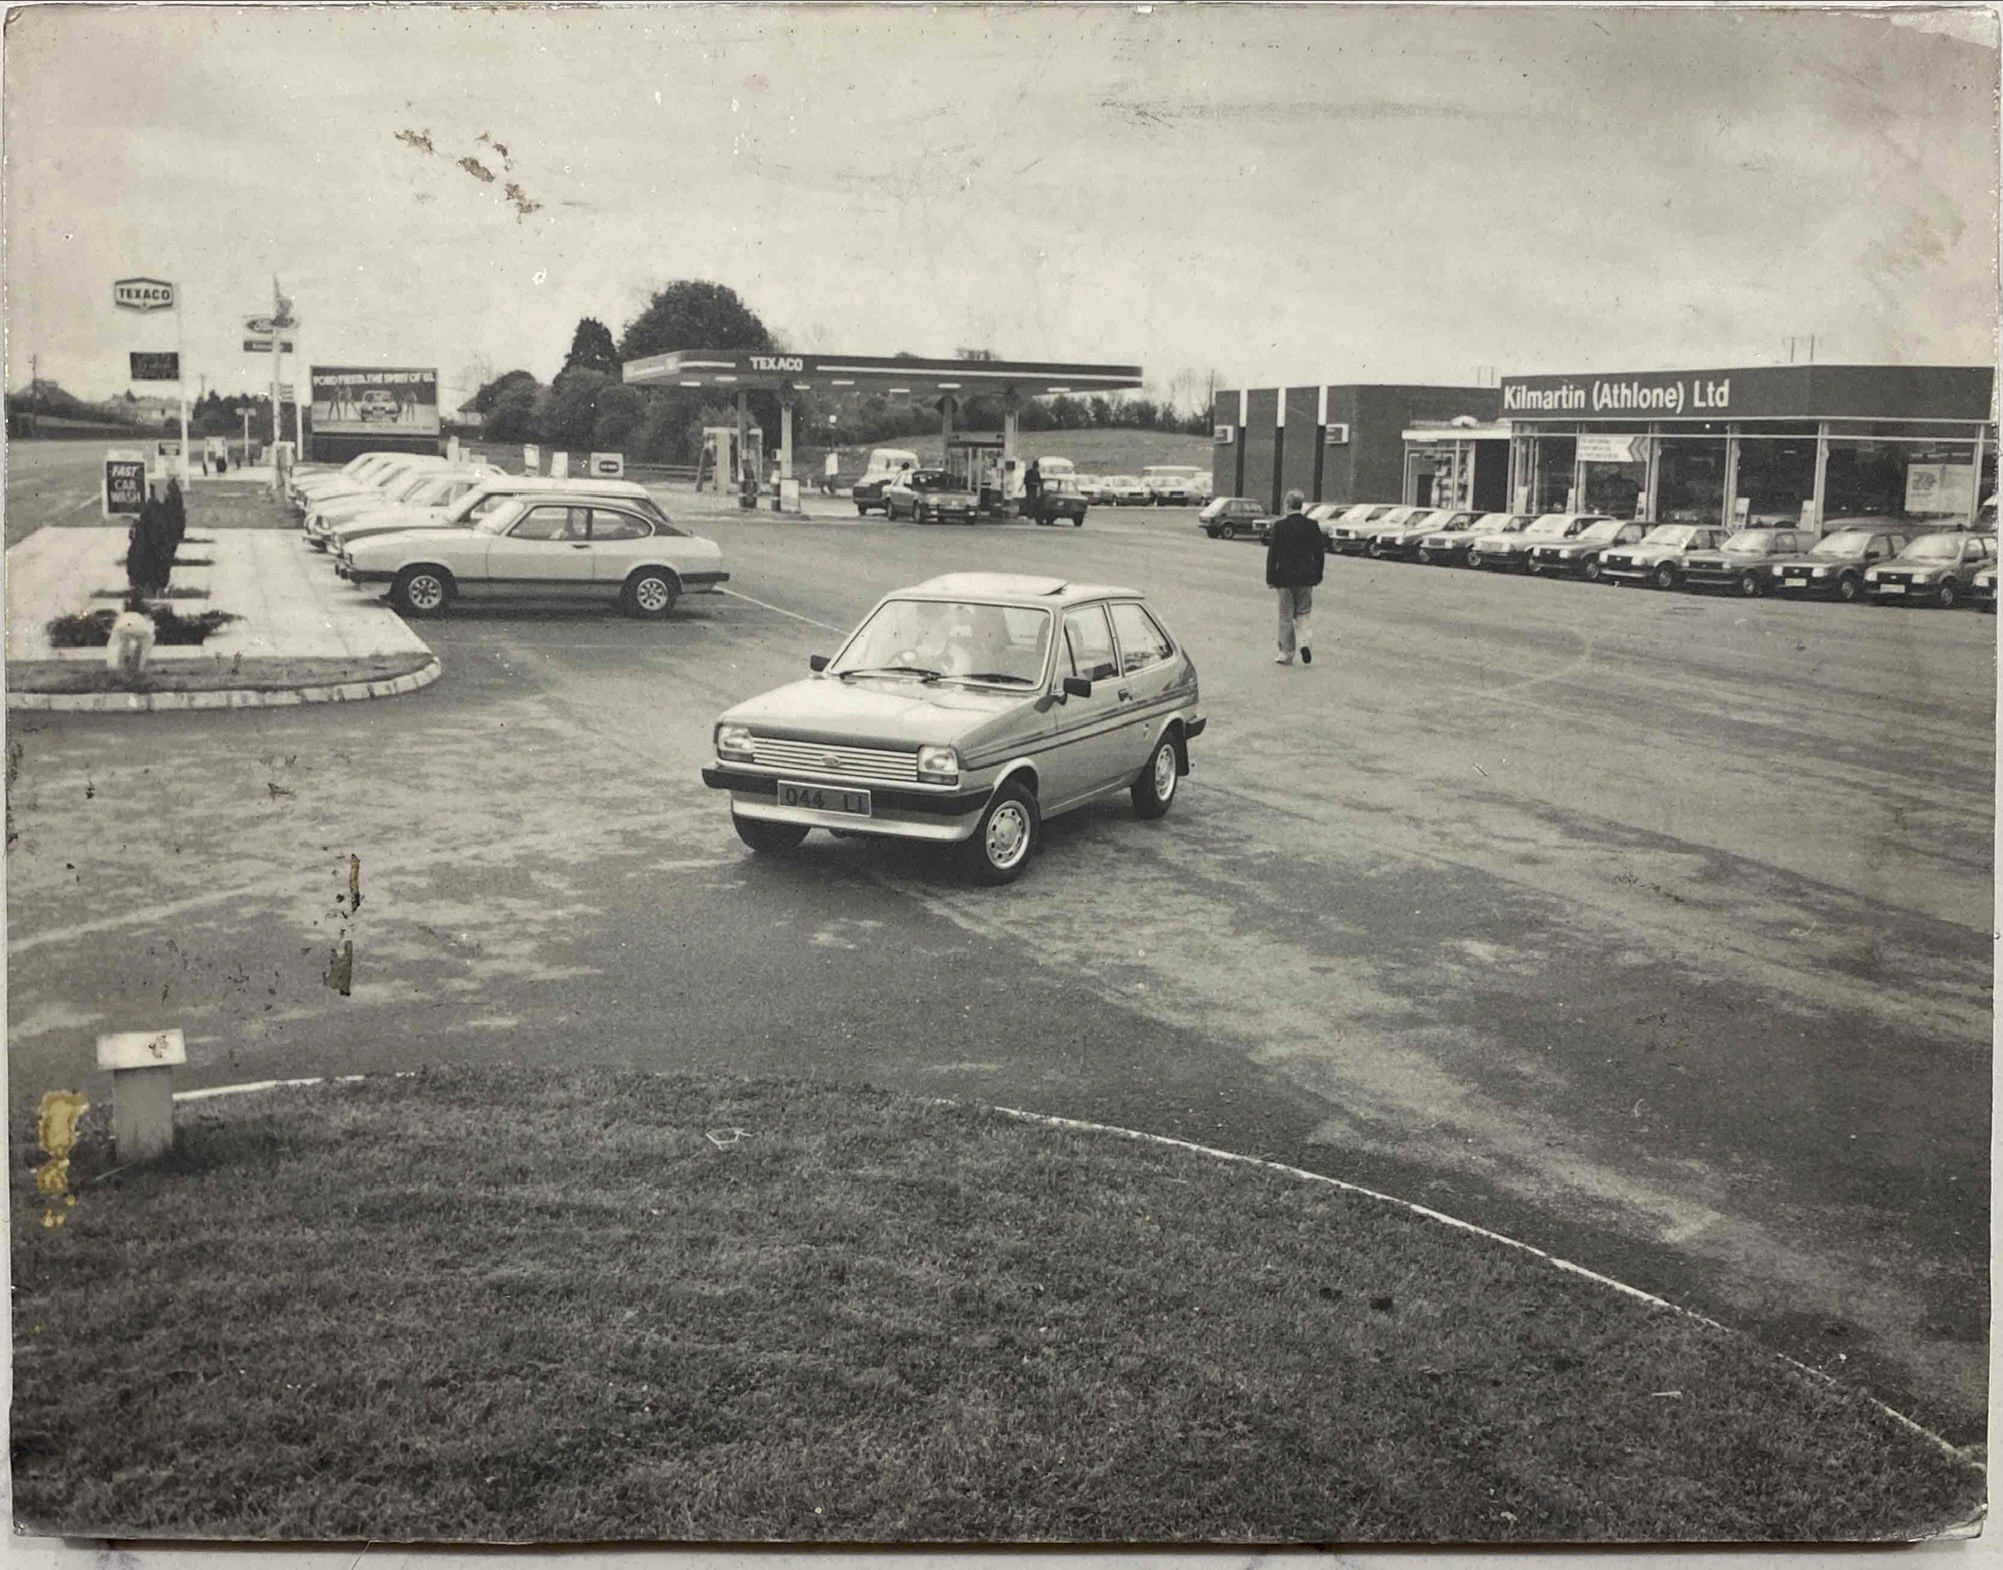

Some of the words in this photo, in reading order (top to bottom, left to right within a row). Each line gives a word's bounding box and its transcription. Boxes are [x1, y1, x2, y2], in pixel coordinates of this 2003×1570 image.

[119, 288, 170, 301] TEXACO
[749, 356, 804, 371] TEXACO
[1503, 385, 1585, 409] Kilmartin
[1592, 381, 1684, 414] (Athlone)
[1693, 379, 1730, 408] Ltd
[111, 465, 140, 477] FAST
[114, 479, 136, 491] CAR
[110, 491, 141, 503] WASH
[785, 787, 825, 808] 044
